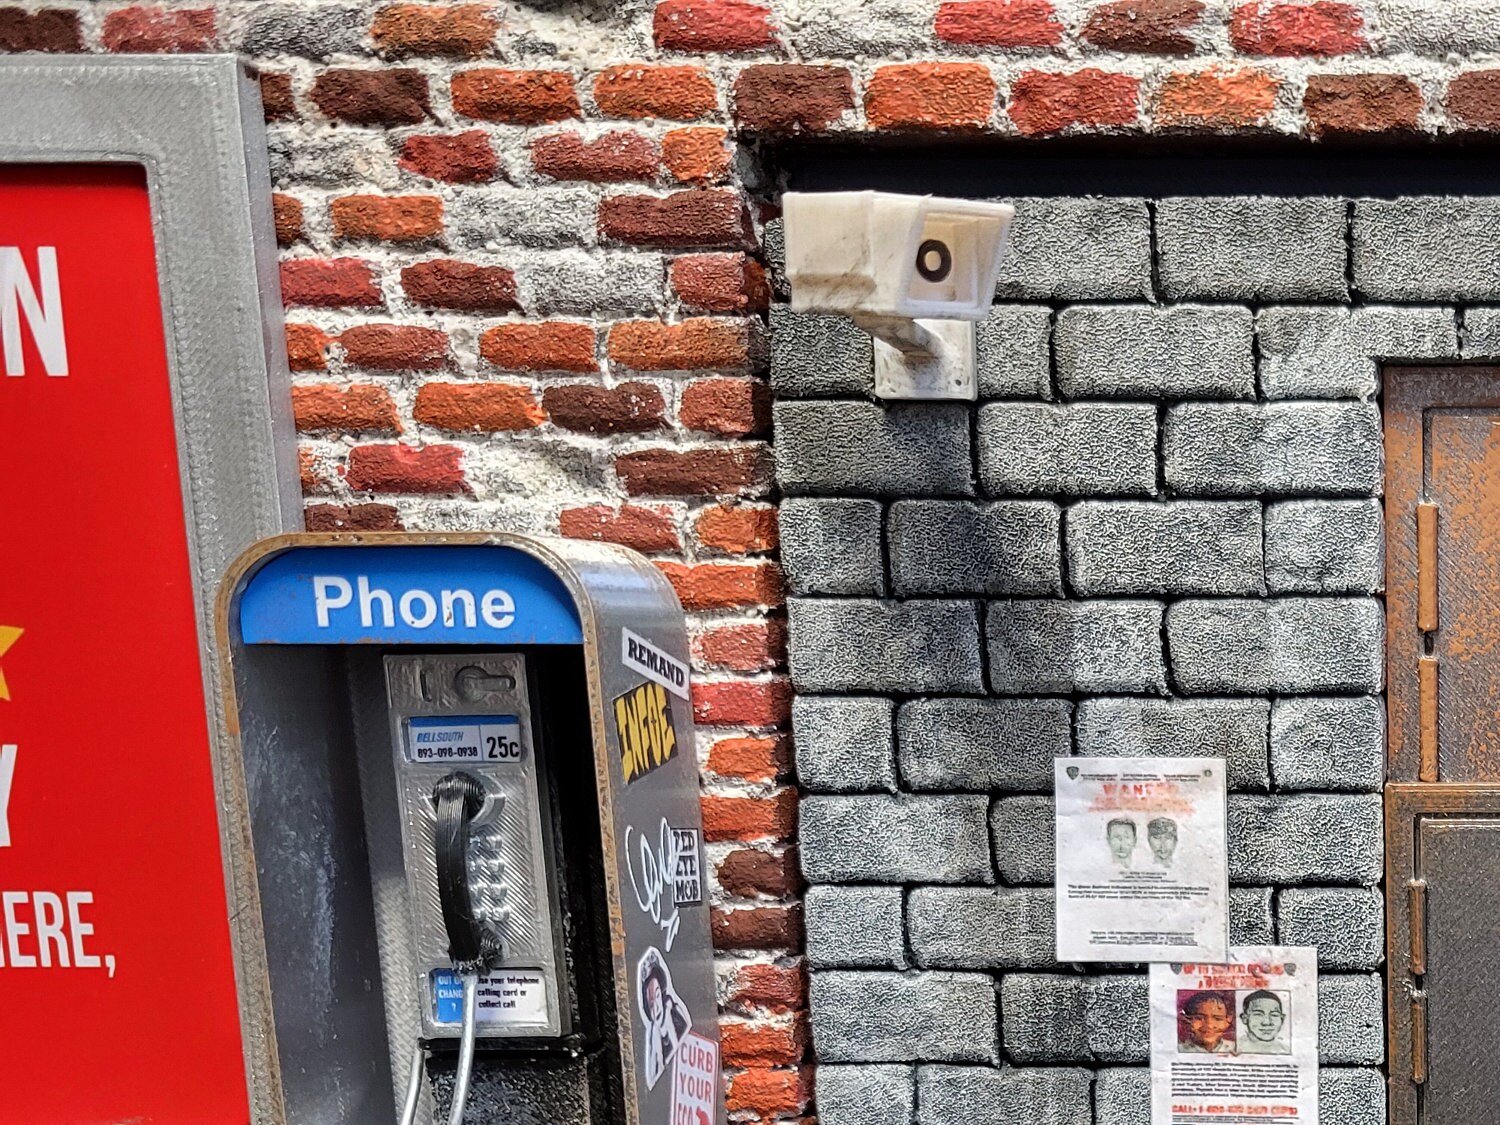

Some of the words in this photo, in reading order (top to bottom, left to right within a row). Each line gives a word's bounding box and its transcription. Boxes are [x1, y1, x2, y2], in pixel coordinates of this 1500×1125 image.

[313, 576, 515, 629] Phone
[627, 637, 685, 687] REMAND
[416, 731, 465, 743] BELLSOUTH
[675, 879, 699, 901] MOB
[0, 891, 116, 978] ERE,
[438, 989, 464, 999] CHANG
[680, 1041, 714, 1074] CURB
[679, 1072, 712, 1103] YOUR
